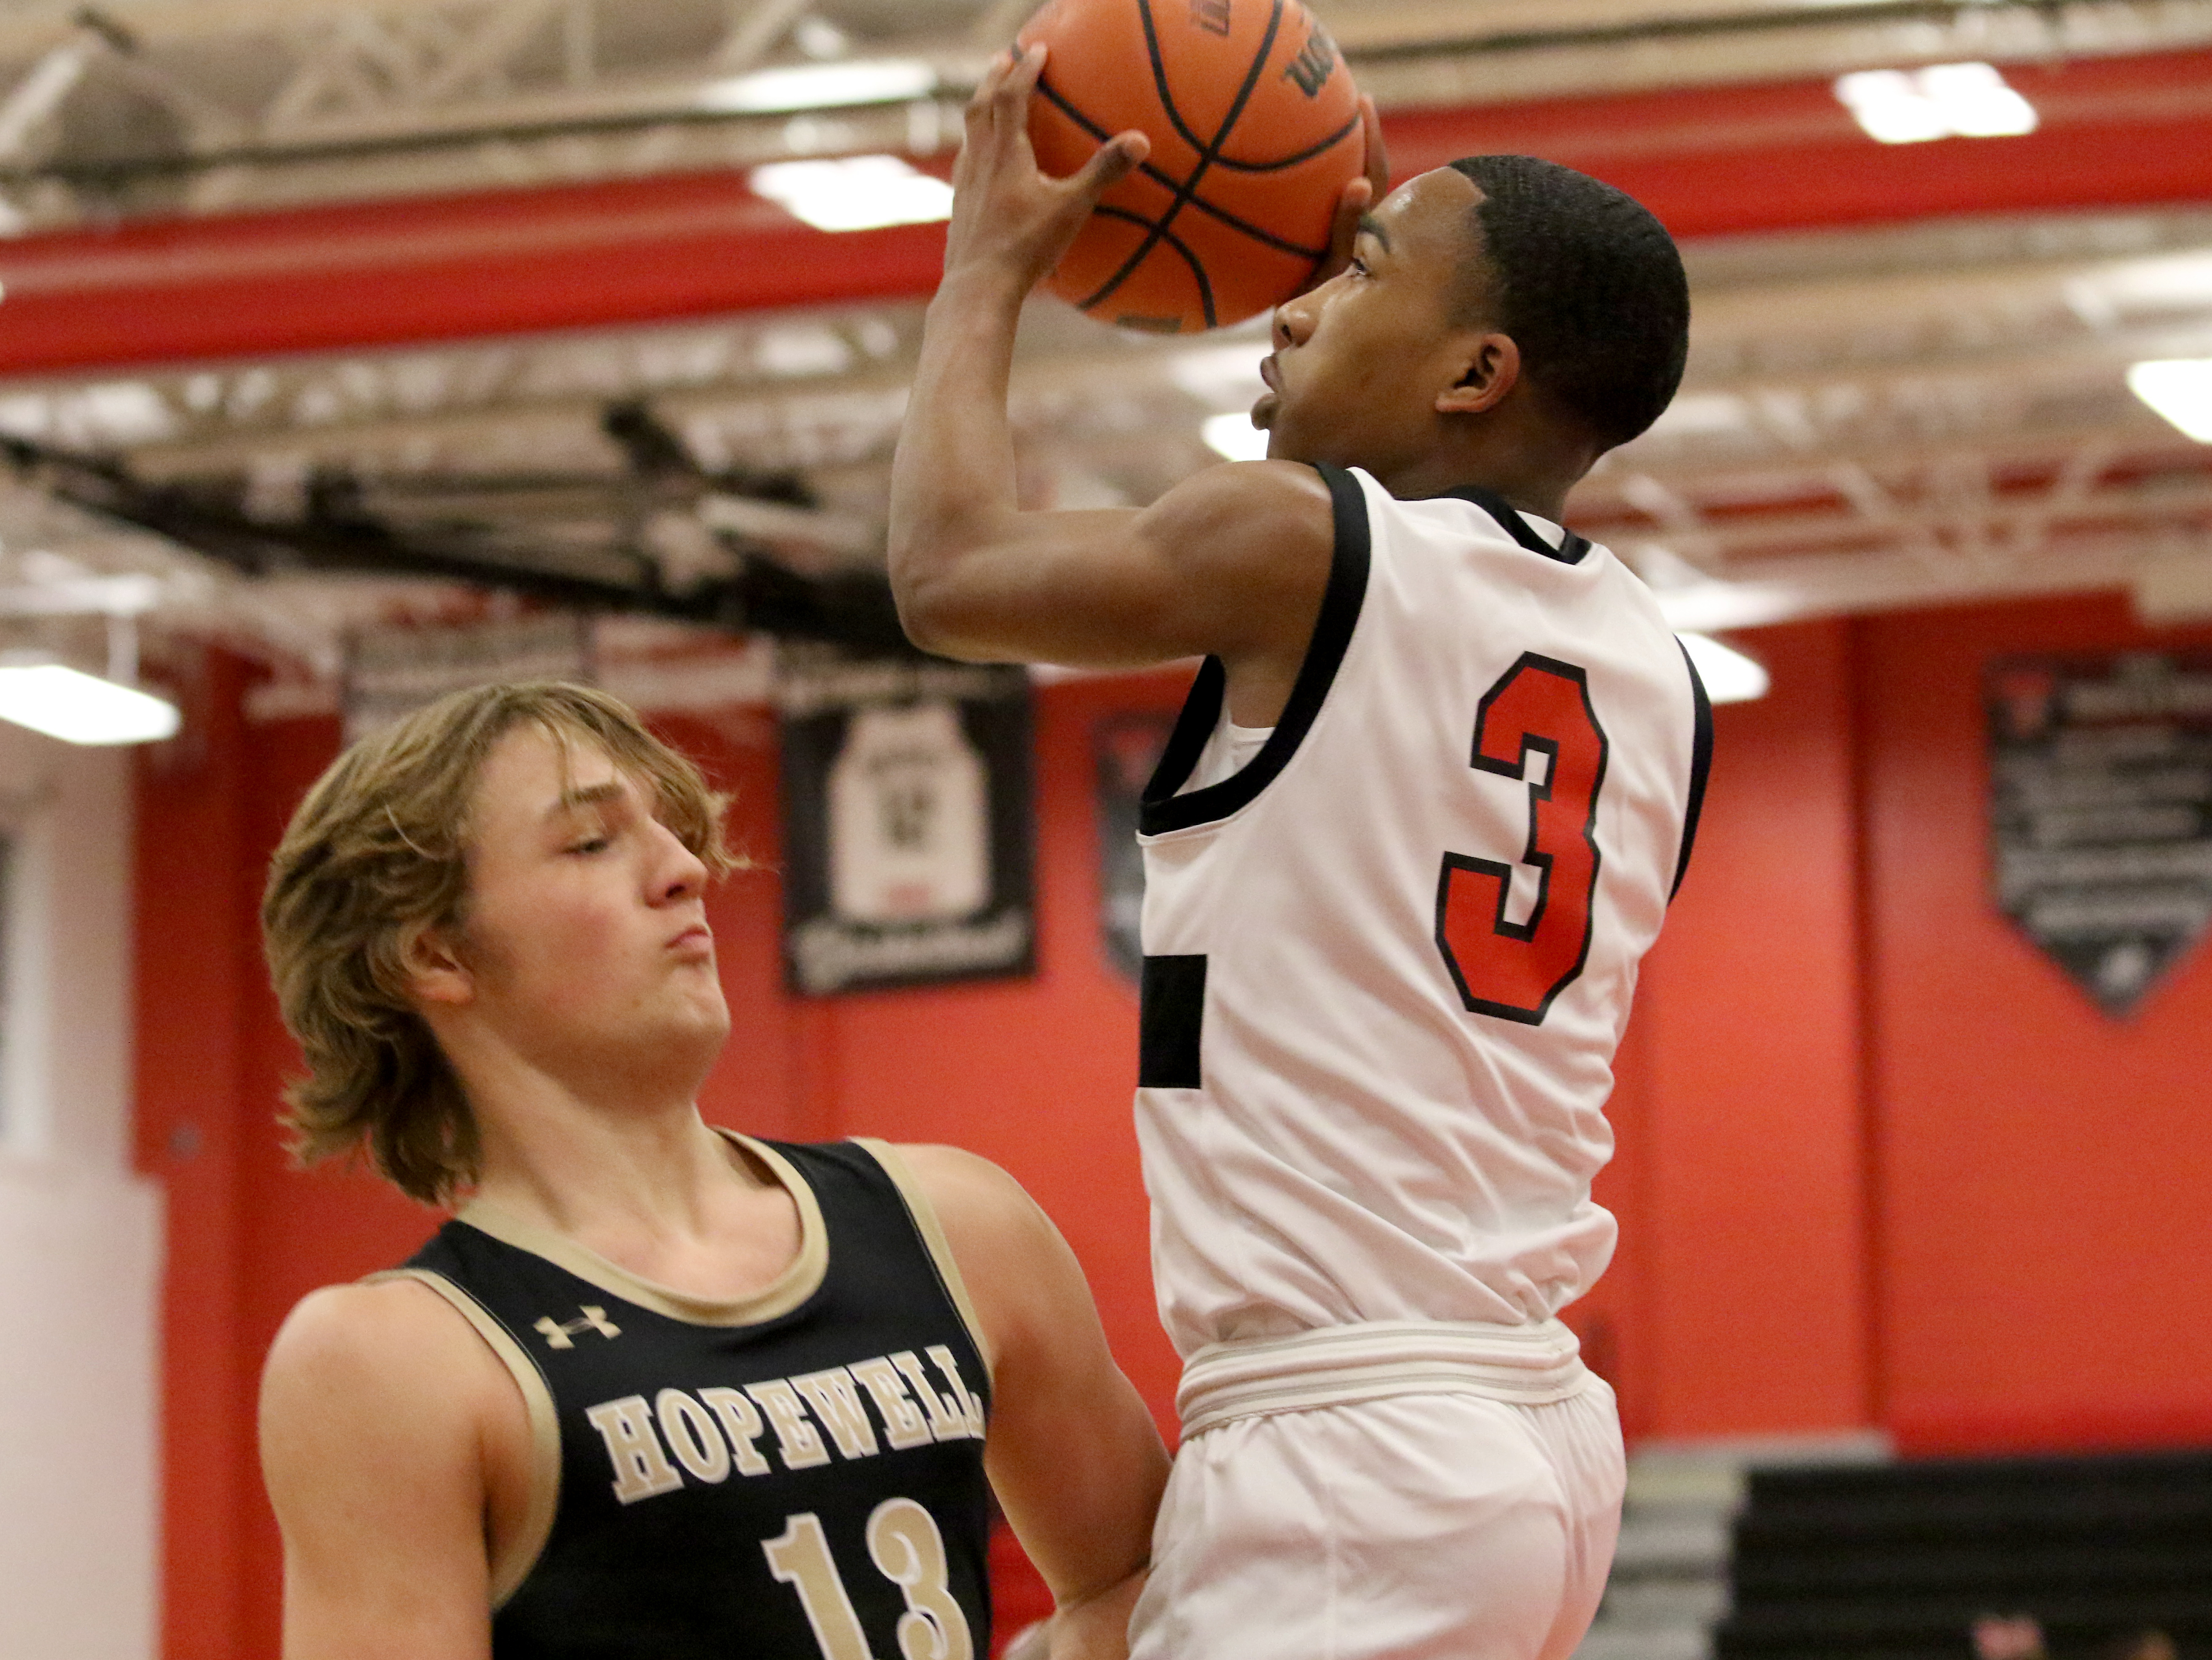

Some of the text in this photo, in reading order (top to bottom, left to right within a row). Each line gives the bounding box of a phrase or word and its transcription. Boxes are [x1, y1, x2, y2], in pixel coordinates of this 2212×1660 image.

[1435, 651, 1608, 1026] 3
[586, 1345, 986, 1505] HOPEWELL
[761, 1497, 974, 1660] 13
